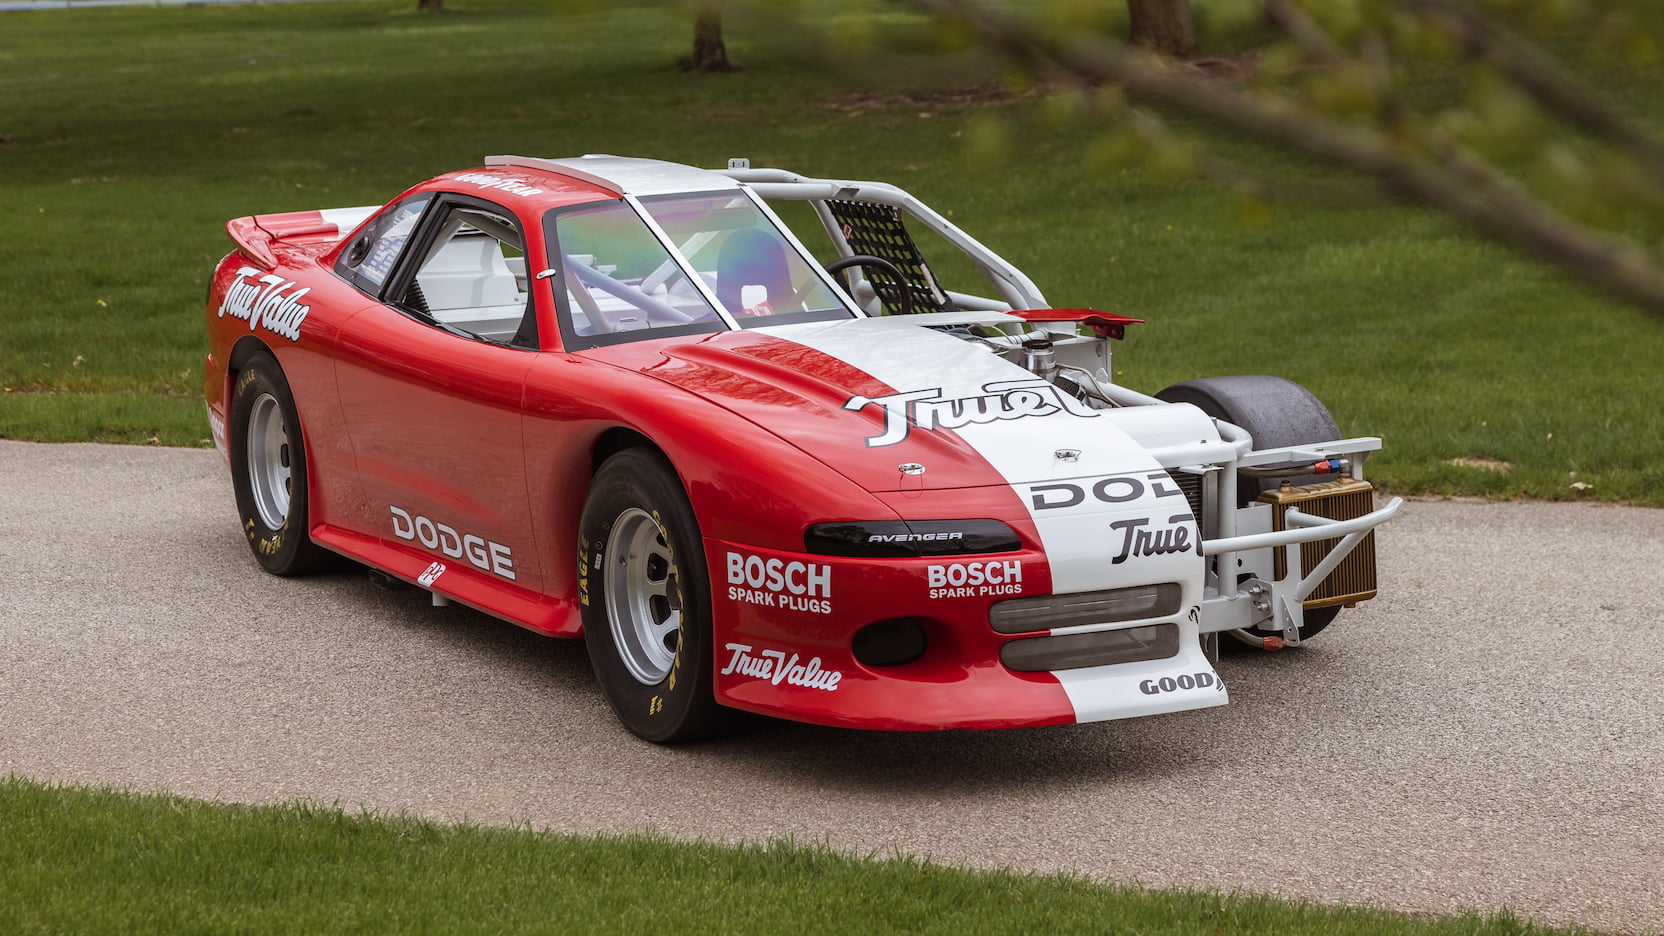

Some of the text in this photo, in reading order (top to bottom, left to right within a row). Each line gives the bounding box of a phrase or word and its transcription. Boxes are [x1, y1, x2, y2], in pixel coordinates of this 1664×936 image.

[389, 504, 516, 581] DODGE
[868, 532, 963, 543] AVENGER
[579, 533, 590, 607] EAGLE
[727, 552, 831, 598] BOSCH
[928, 560, 1022, 588] BOSCH
[728, 586, 832, 614] SPARK PLUGS
[929, 584, 1022, 599] SPARK PLUGS
